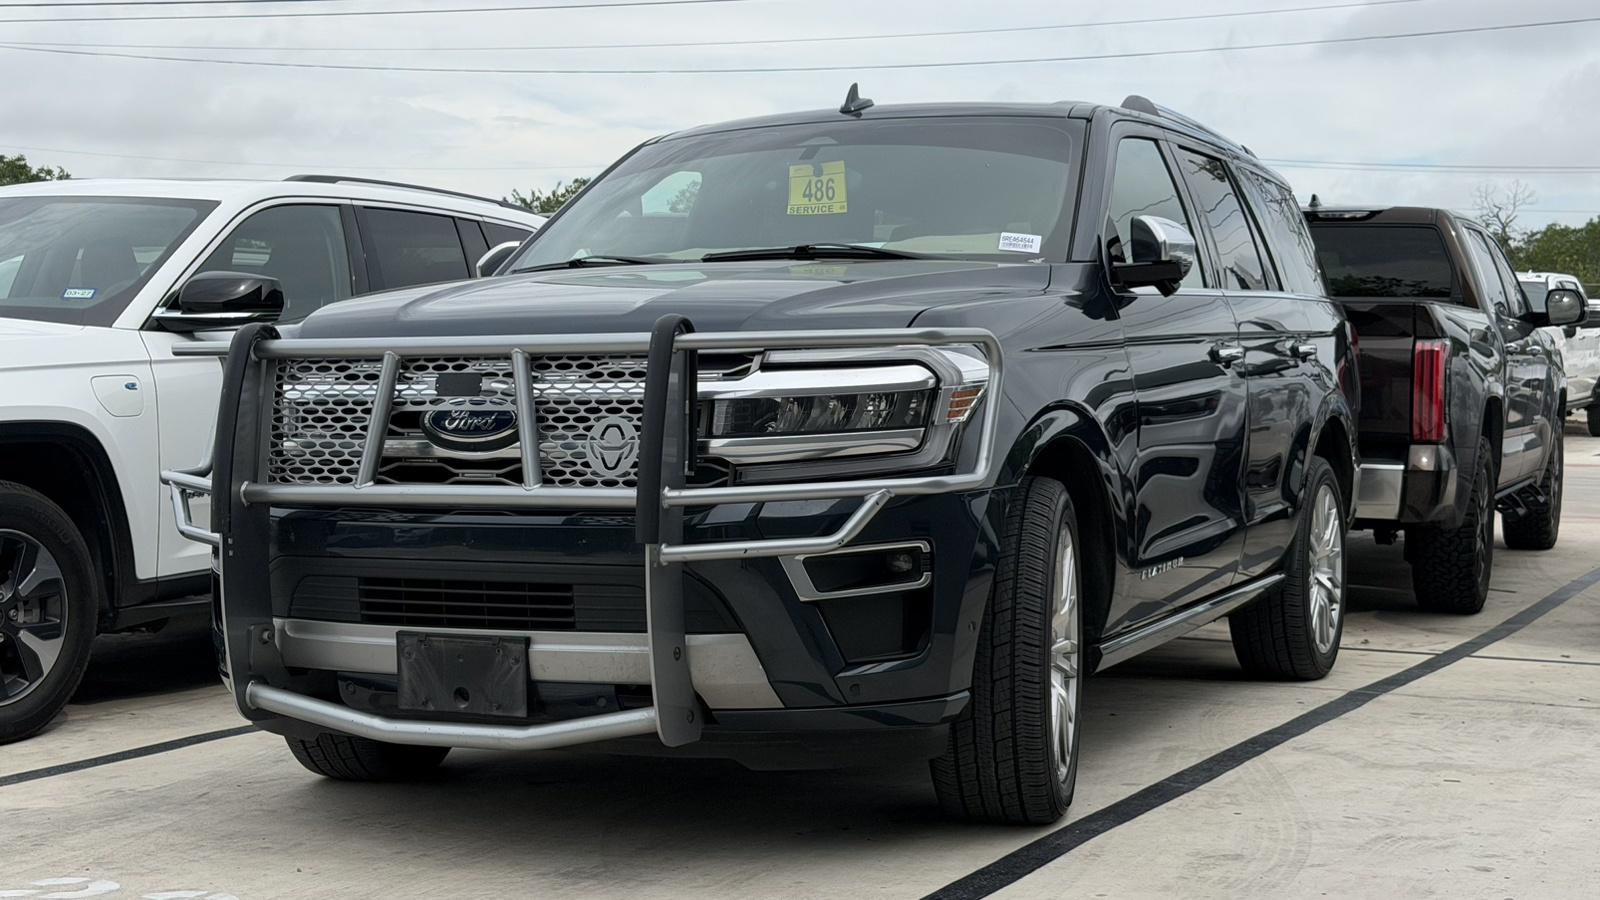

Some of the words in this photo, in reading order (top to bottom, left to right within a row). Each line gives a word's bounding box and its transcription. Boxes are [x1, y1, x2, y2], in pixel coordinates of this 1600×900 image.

[802, 177, 836, 202] 486
[788, 204, 834, 214] SERVICE
[445, 409, 498, 430] Ford
[1141, 556, 1184, 580] PLATINUM
